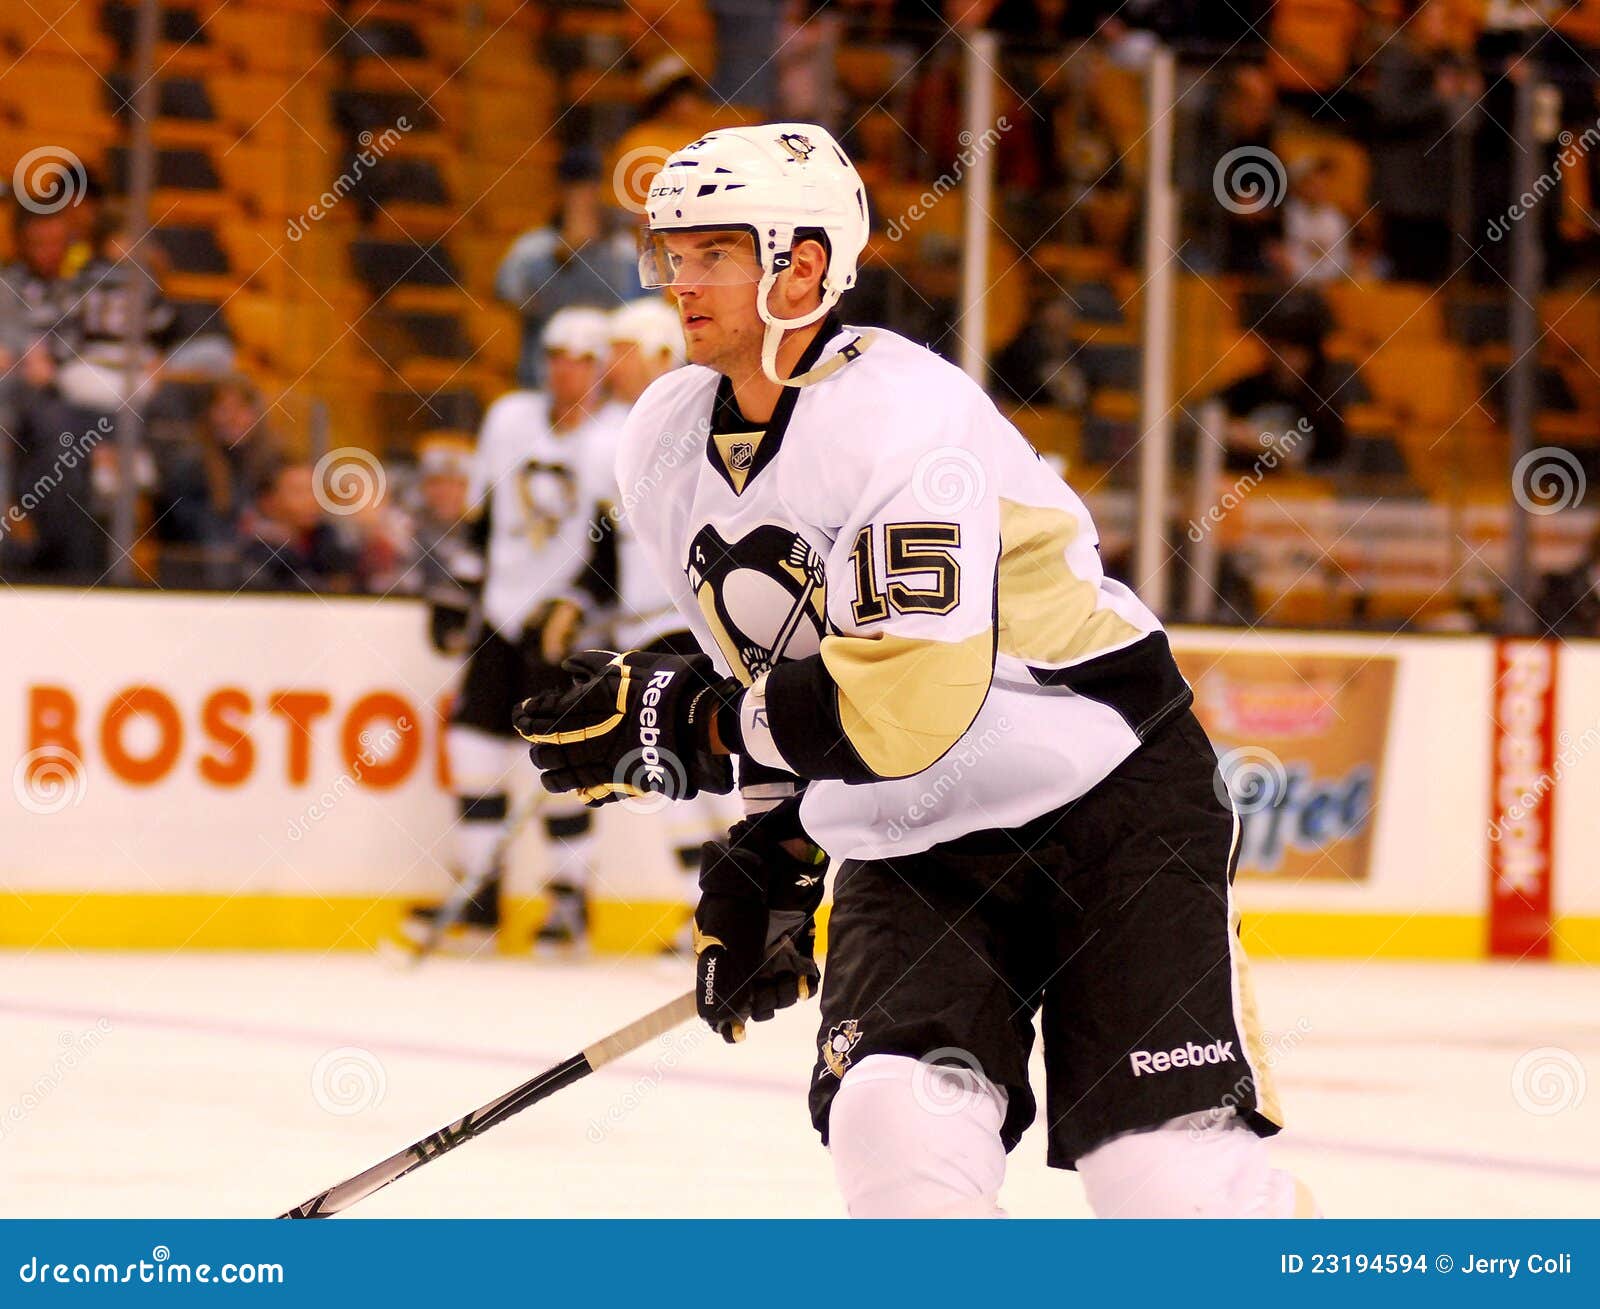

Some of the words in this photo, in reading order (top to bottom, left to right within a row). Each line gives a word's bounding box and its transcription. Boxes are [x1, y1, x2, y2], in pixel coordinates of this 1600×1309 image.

[651, 186, 685, 198] CCM
[848, 521, 961, 627] 15
[27, 684, 452, 794] BOSTO
[640, 670, 676, 784] Reebok
[705, 957, 717, 1005] Reebok
[1129, 1039, 1237, 1077] Reebok
